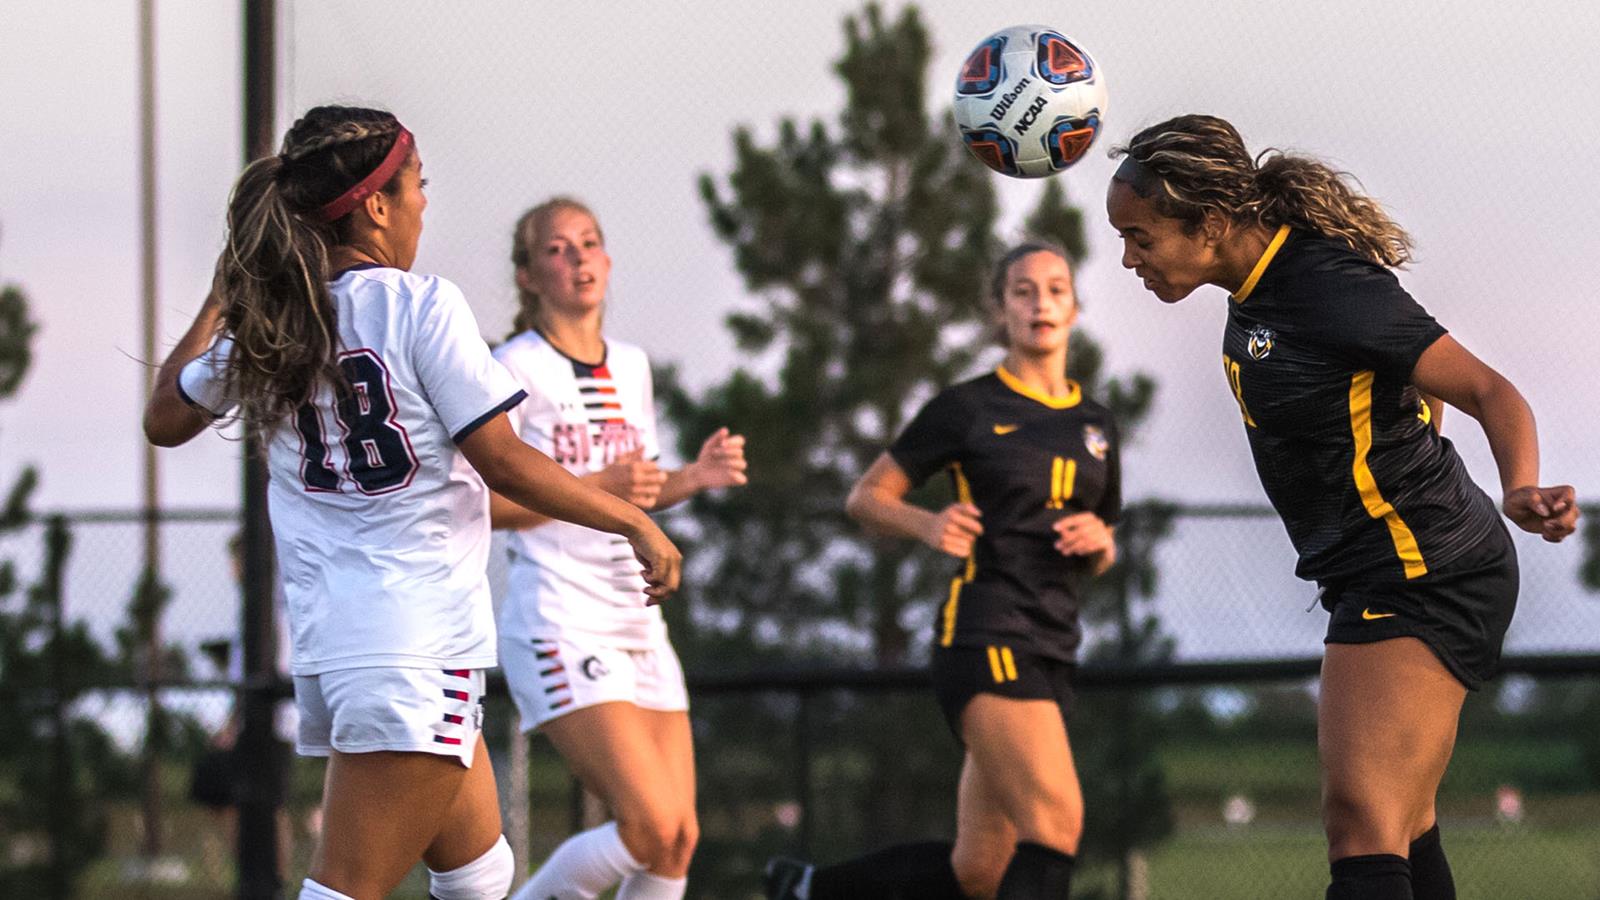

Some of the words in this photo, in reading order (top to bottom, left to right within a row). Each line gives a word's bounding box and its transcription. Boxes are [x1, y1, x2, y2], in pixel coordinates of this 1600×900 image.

[990, 77, 1031, 121] Wilson
[1013, 96, 1049, 136] NCAA
[291, 347, 420, 496] 18
[1047, 456, 1077, 509] 11
[987, 645, 1018, 683] 11
